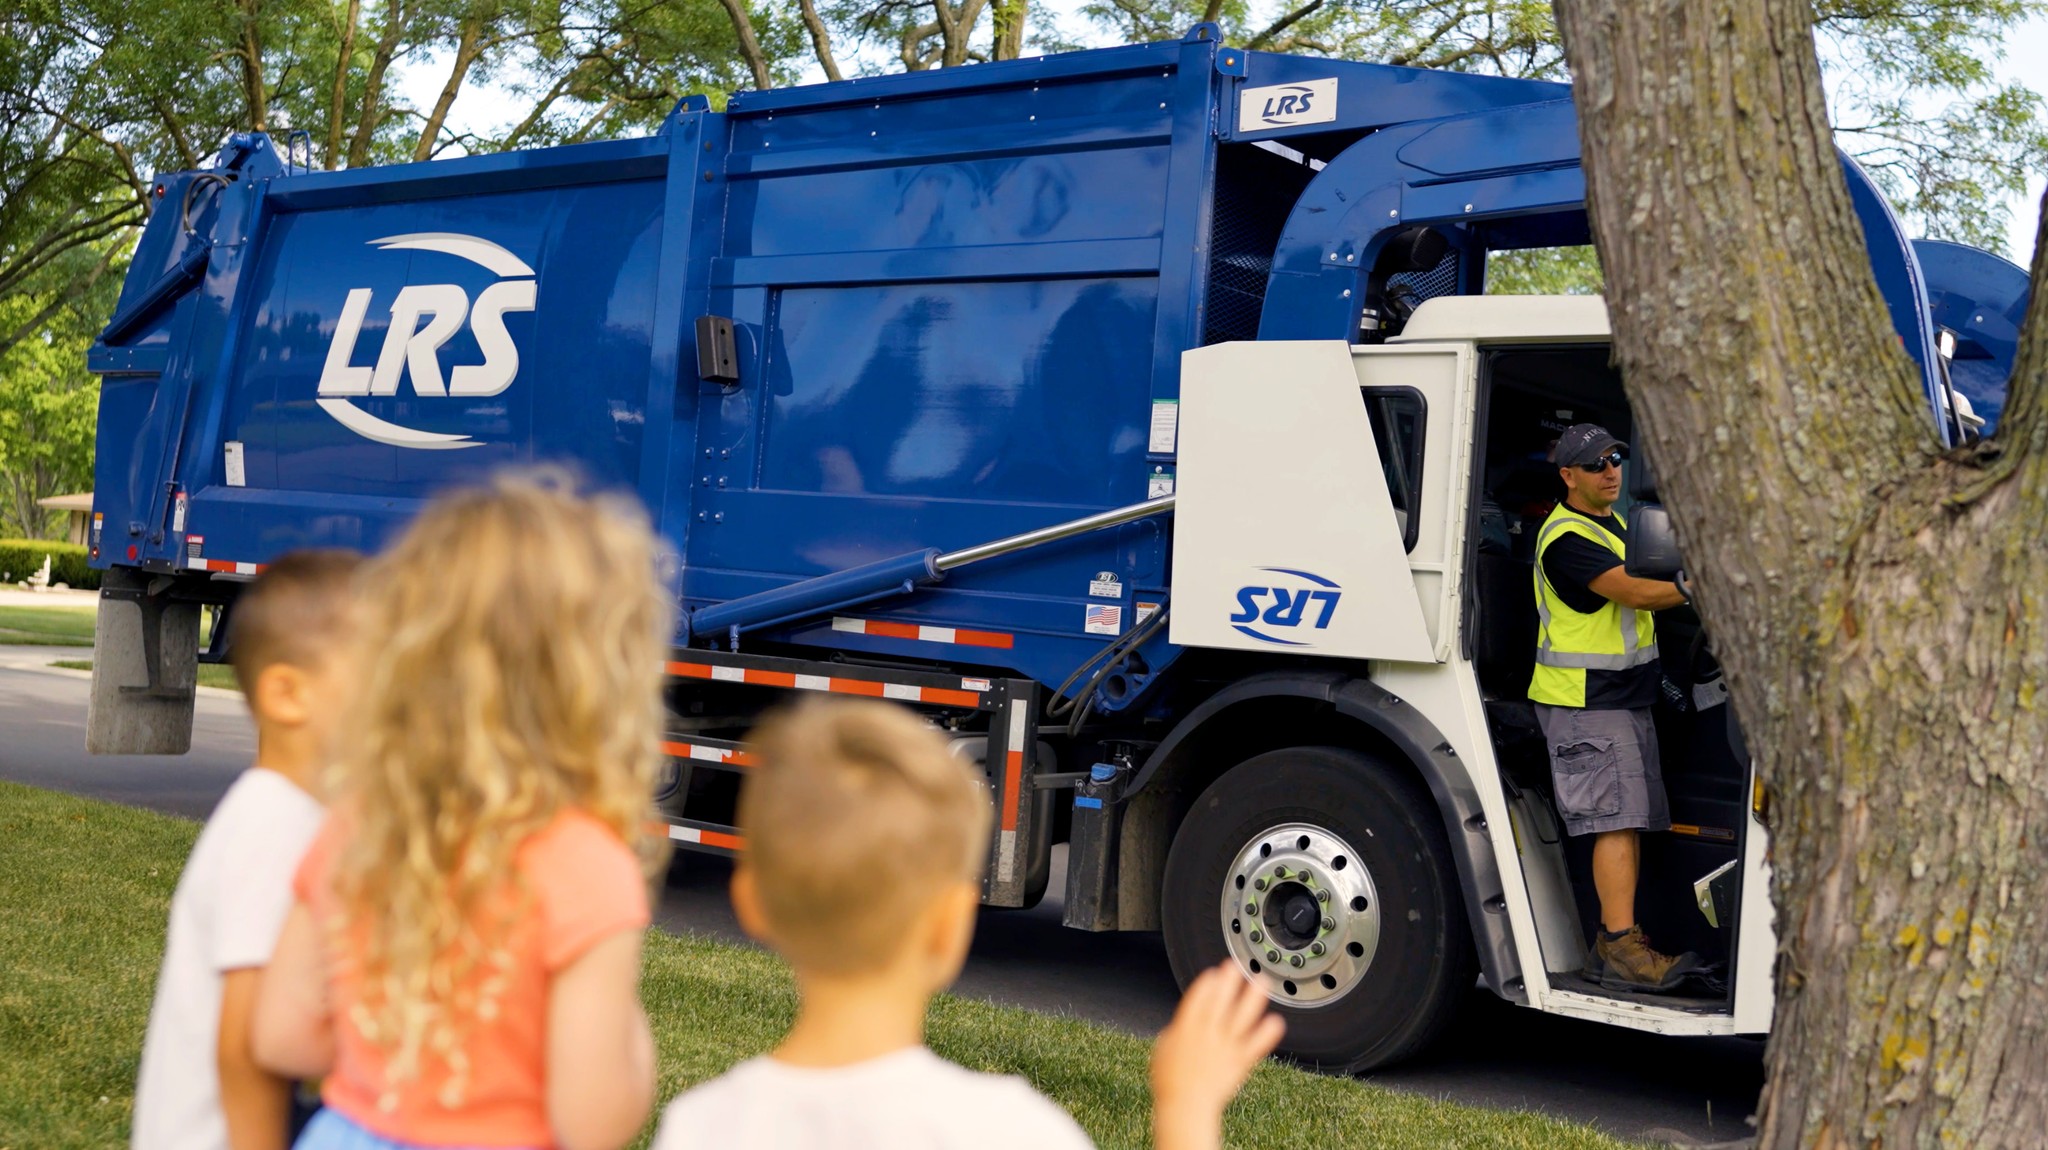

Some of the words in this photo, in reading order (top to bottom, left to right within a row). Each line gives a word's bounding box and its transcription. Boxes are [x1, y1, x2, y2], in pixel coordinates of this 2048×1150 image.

[1262, 92, 1314, 117] LRS
[317, 279, 538, 397] LRS
[1540, 419, 1566, 432] MAC
[1230, 586, 1342, 629] LRS
